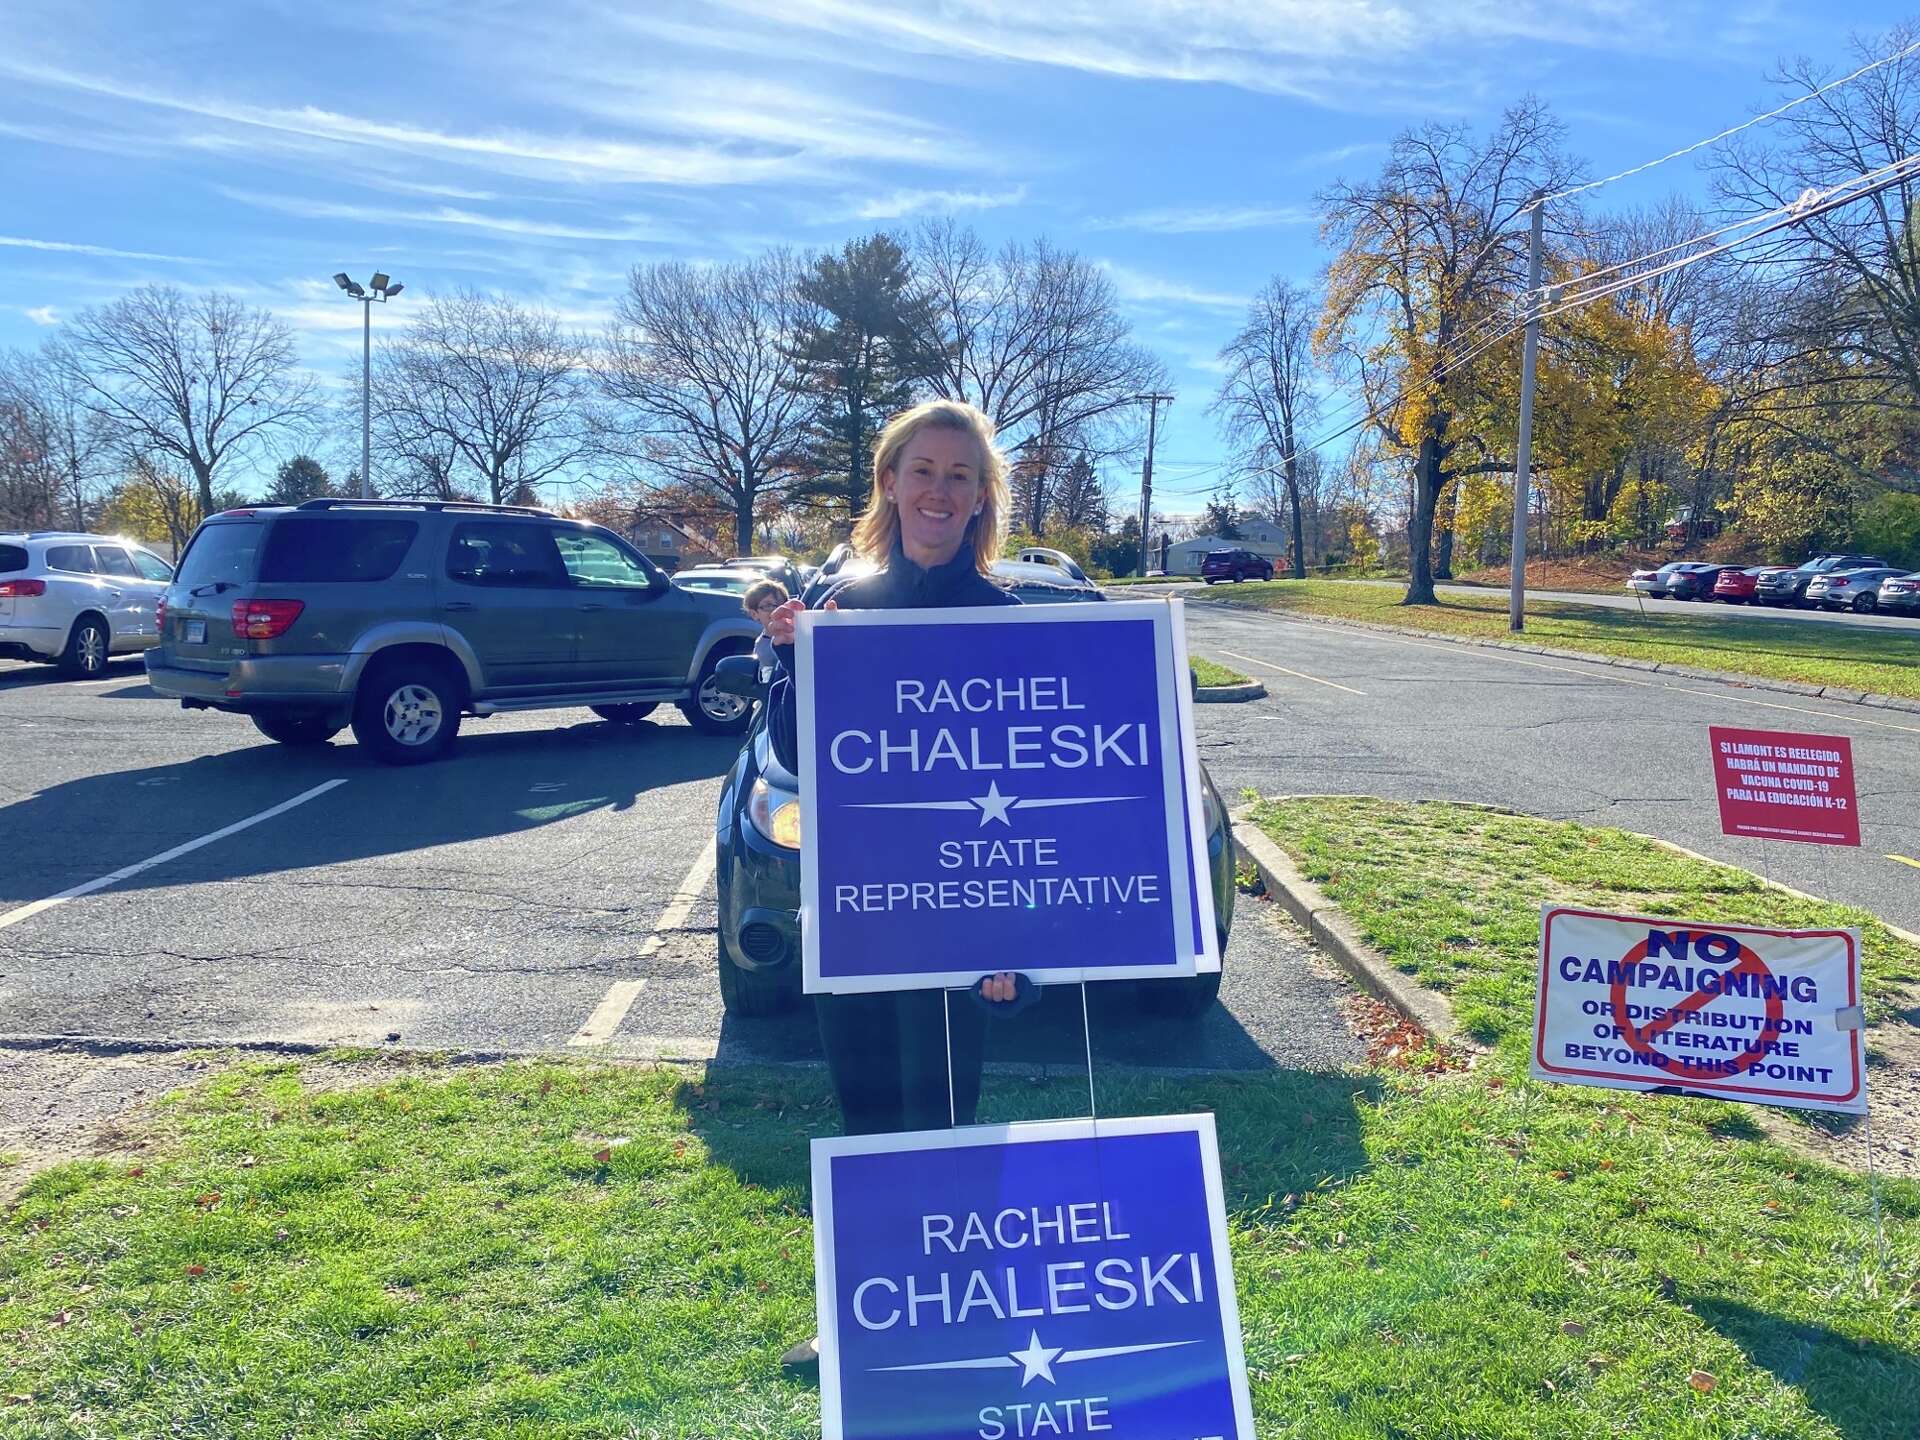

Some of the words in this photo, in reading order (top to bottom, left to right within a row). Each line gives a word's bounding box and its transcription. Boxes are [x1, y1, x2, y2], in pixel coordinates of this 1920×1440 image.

[896, 677, 1085, 713] RACHEL
[830, 724, 1148, 774] CHALESKI
[1720, 742, 1731, 753] SI
[1733, 743, 1772, 757] LAMONT
[1775, 746, 1787, 758] ES
[1727, 758, 1760, 771] HABRÁ
[1762, 760, 1776, 772] UN
[1778, 762, 1825, 777] MANDATO
[1827, 766, 1840, 778] DE
[1741, 774, 1781, 788] VACUNA
[1783, 778, 1829, 792] COVID-19
[1726, 788, 1752, 801] PARA
[1754, 790, 1766, 802] LA
[1768, 792, 1824, 807] EDUCACIÓN
[1825, 798, 1847, 809] K-12
[939, 838, 1058, 868] STATE
[835, 875, 1160, 912] REPRESENTATIVE
[1647, 929, 1740, 964] NO
[1559, 956, 1818, 1003] CAMPAIGNING
[1582, 1000, 1616, 1017] OR
[1626, 1004, 1812, 1035] DISTRIBUTION
[1593, 1023, 1626, 1039] OF
[1635, 1028, 1799, 1057] LITERATURE
[1565, 1043, 1668, 1067] BEYOND
[1678, 1055, 1739, 1075] THIS
[1749, 1063, 1832, 1083] POINT
[922, 1201, 1130, 1255] RACHEL
[853, 1252, 1204, 1330] CHALESKI
[978, 1396, 1112, 1440] STATE
